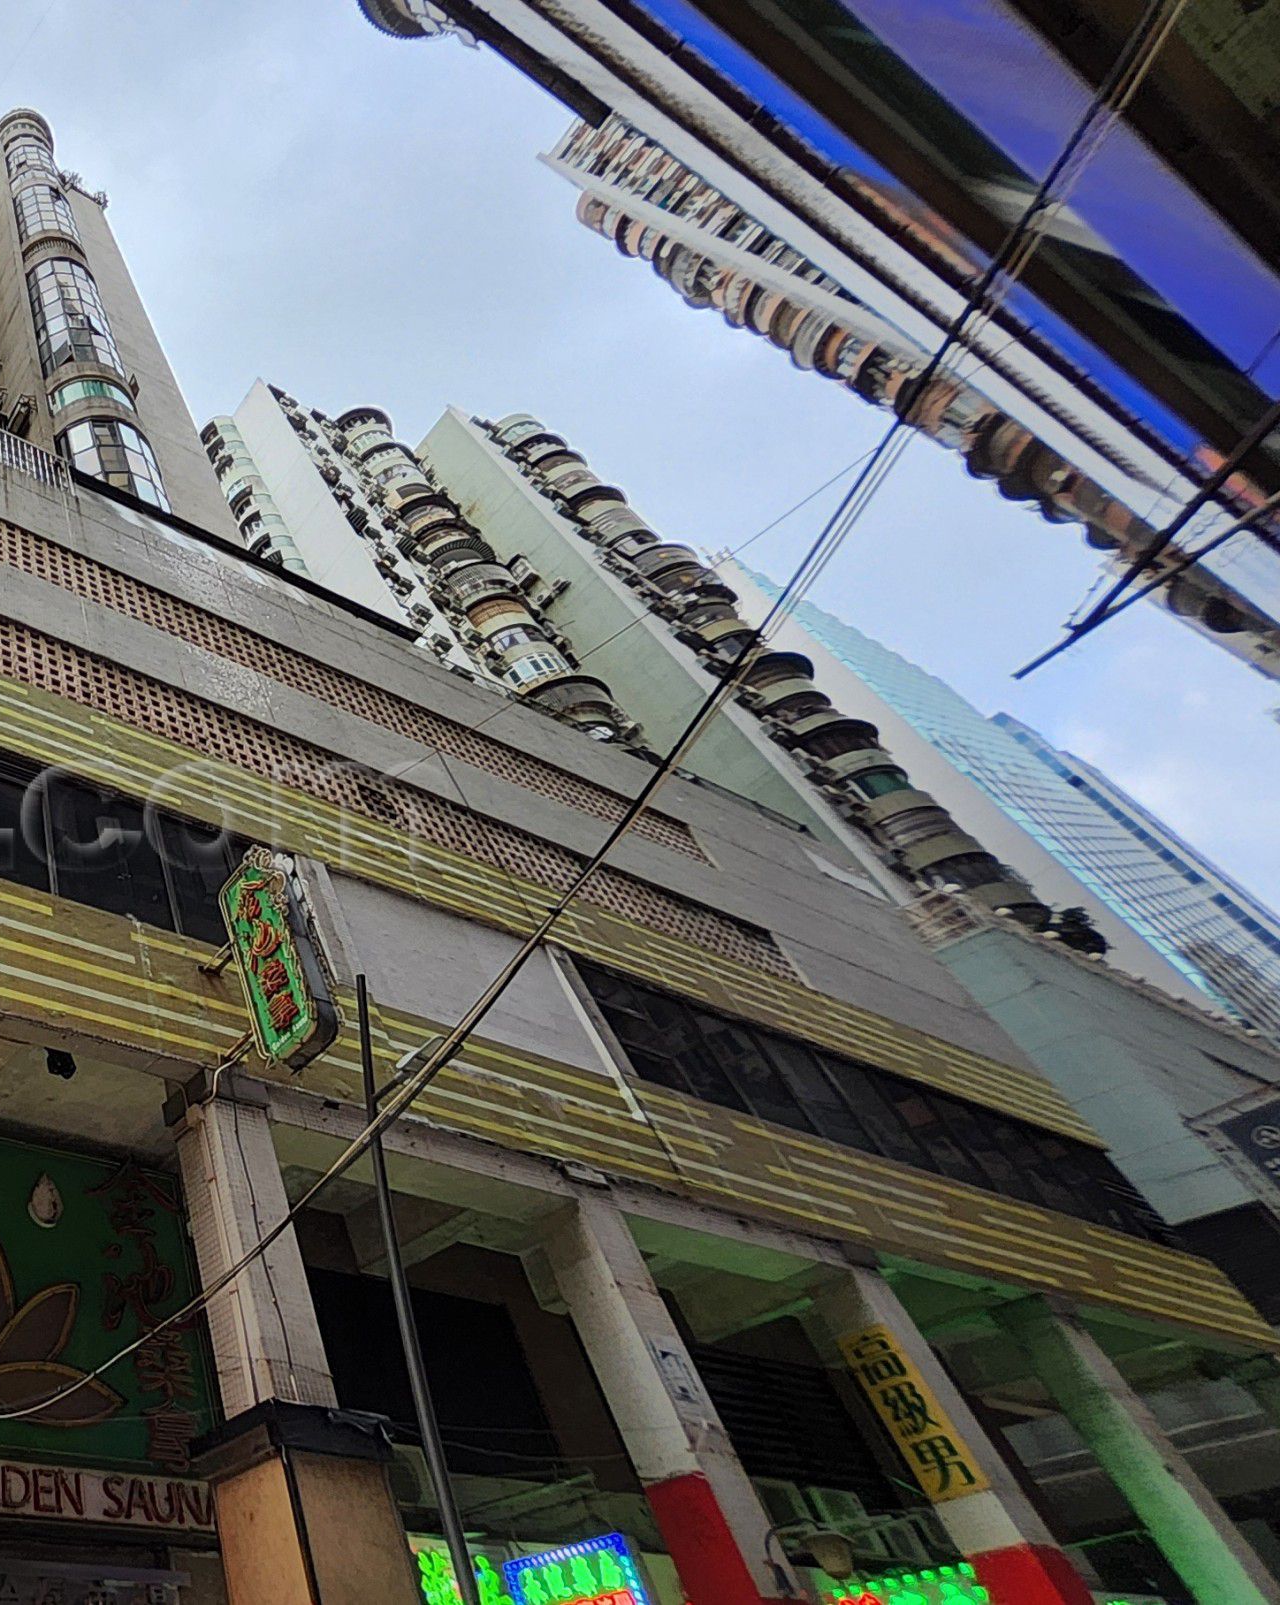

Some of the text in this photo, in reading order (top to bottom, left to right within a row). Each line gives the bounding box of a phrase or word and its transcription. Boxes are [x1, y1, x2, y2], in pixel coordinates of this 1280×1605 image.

[851, 1332, 977, 1493] 高級男
[102, 1476, 214, 1526] SAUN
